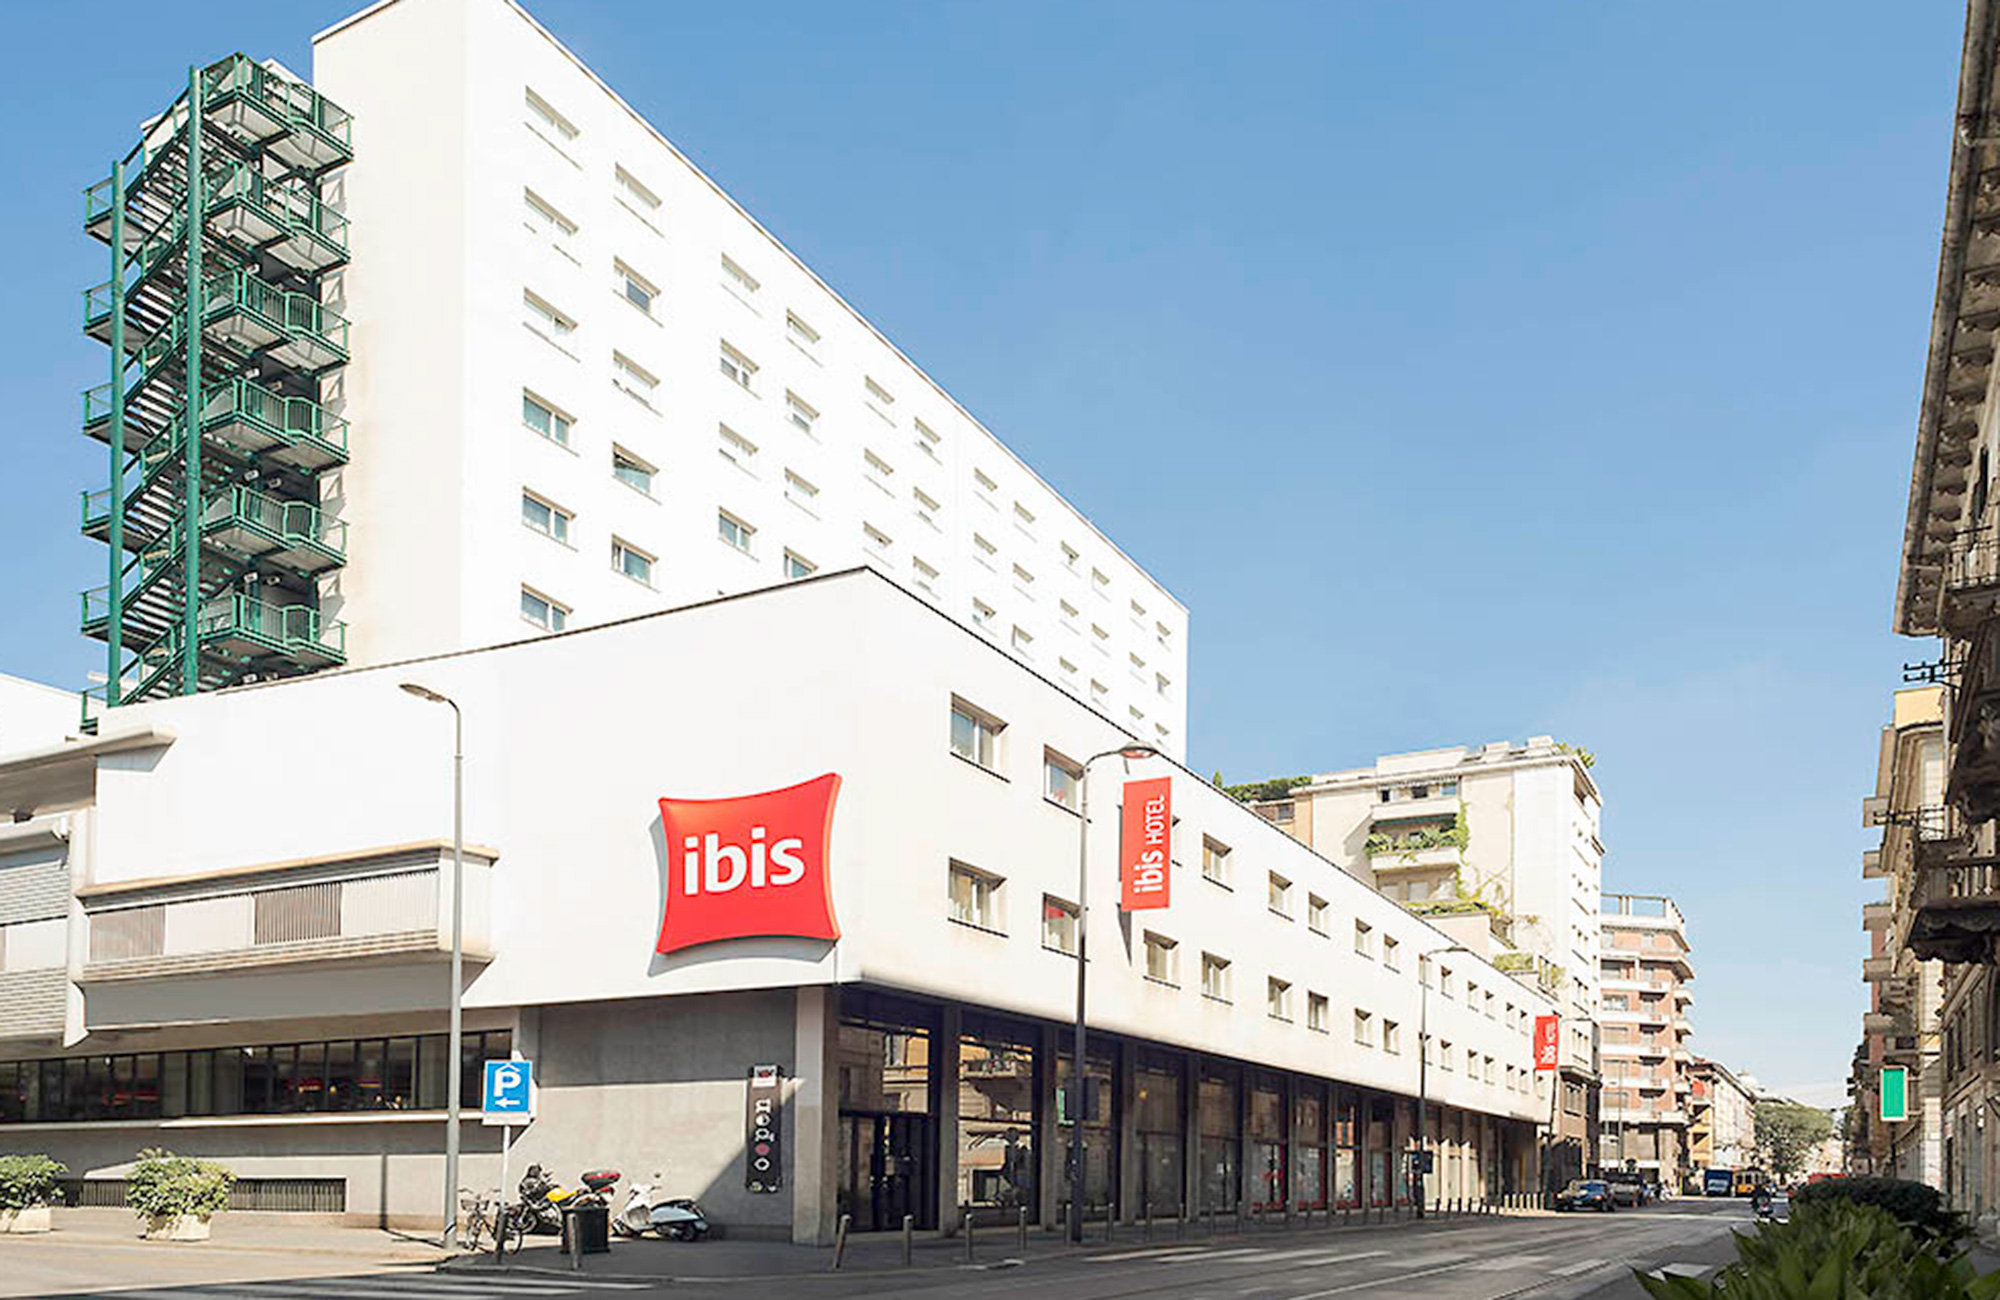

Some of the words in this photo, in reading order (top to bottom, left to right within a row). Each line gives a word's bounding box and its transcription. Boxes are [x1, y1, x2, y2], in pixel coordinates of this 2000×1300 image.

[1145, 794, 1165, 845] HOTEL
[684, 826, 805, 896] ibis
[1134, 849, 1164, 893] ibis
[493, 1068, 522, 1097] P
